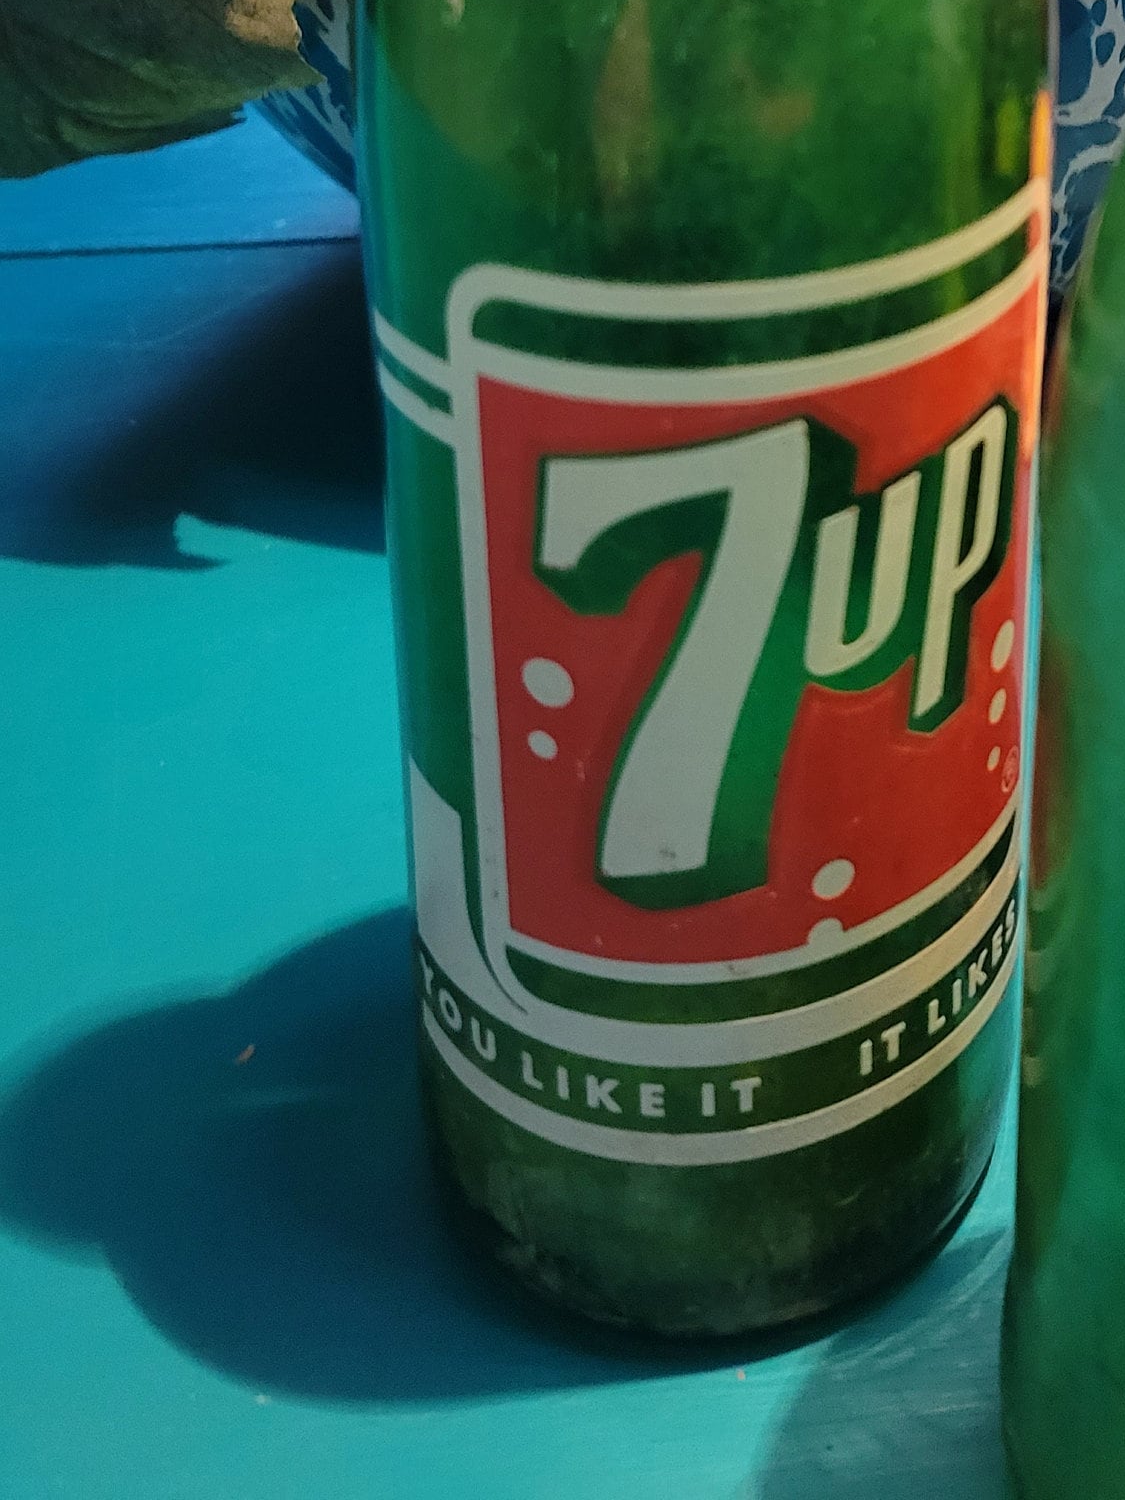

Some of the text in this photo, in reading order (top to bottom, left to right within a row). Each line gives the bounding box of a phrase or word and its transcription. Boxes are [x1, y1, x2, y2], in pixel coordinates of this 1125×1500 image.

[420, 898, 1017, 1118] YOU LIKE IT IT LIKES
